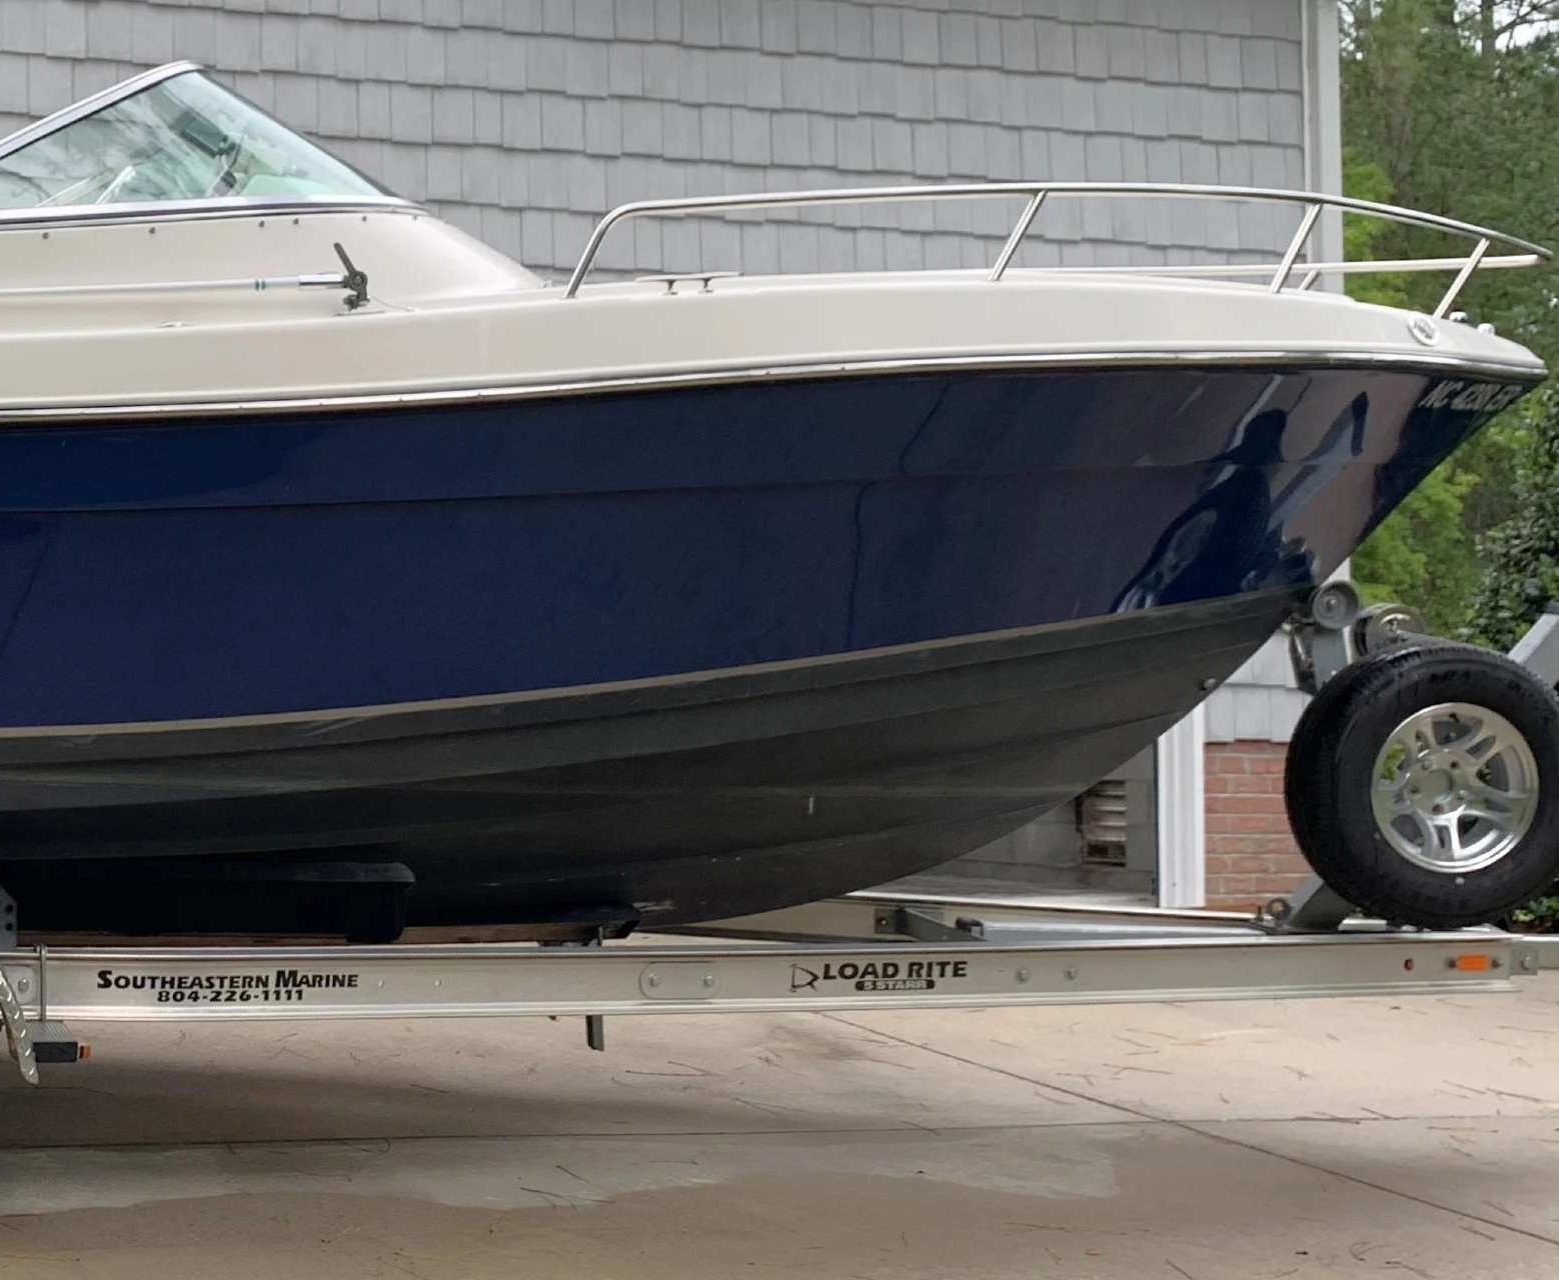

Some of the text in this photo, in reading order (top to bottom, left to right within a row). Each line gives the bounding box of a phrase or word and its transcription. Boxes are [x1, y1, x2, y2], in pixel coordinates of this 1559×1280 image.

[823, 961, 968, 980] LOAD RITE
[97, 969, 359, 989] SOUTHEASTERN MARINE
[863, 980, 875, 990] 5
[157, 990, 304, 1003] 804-226-1111
